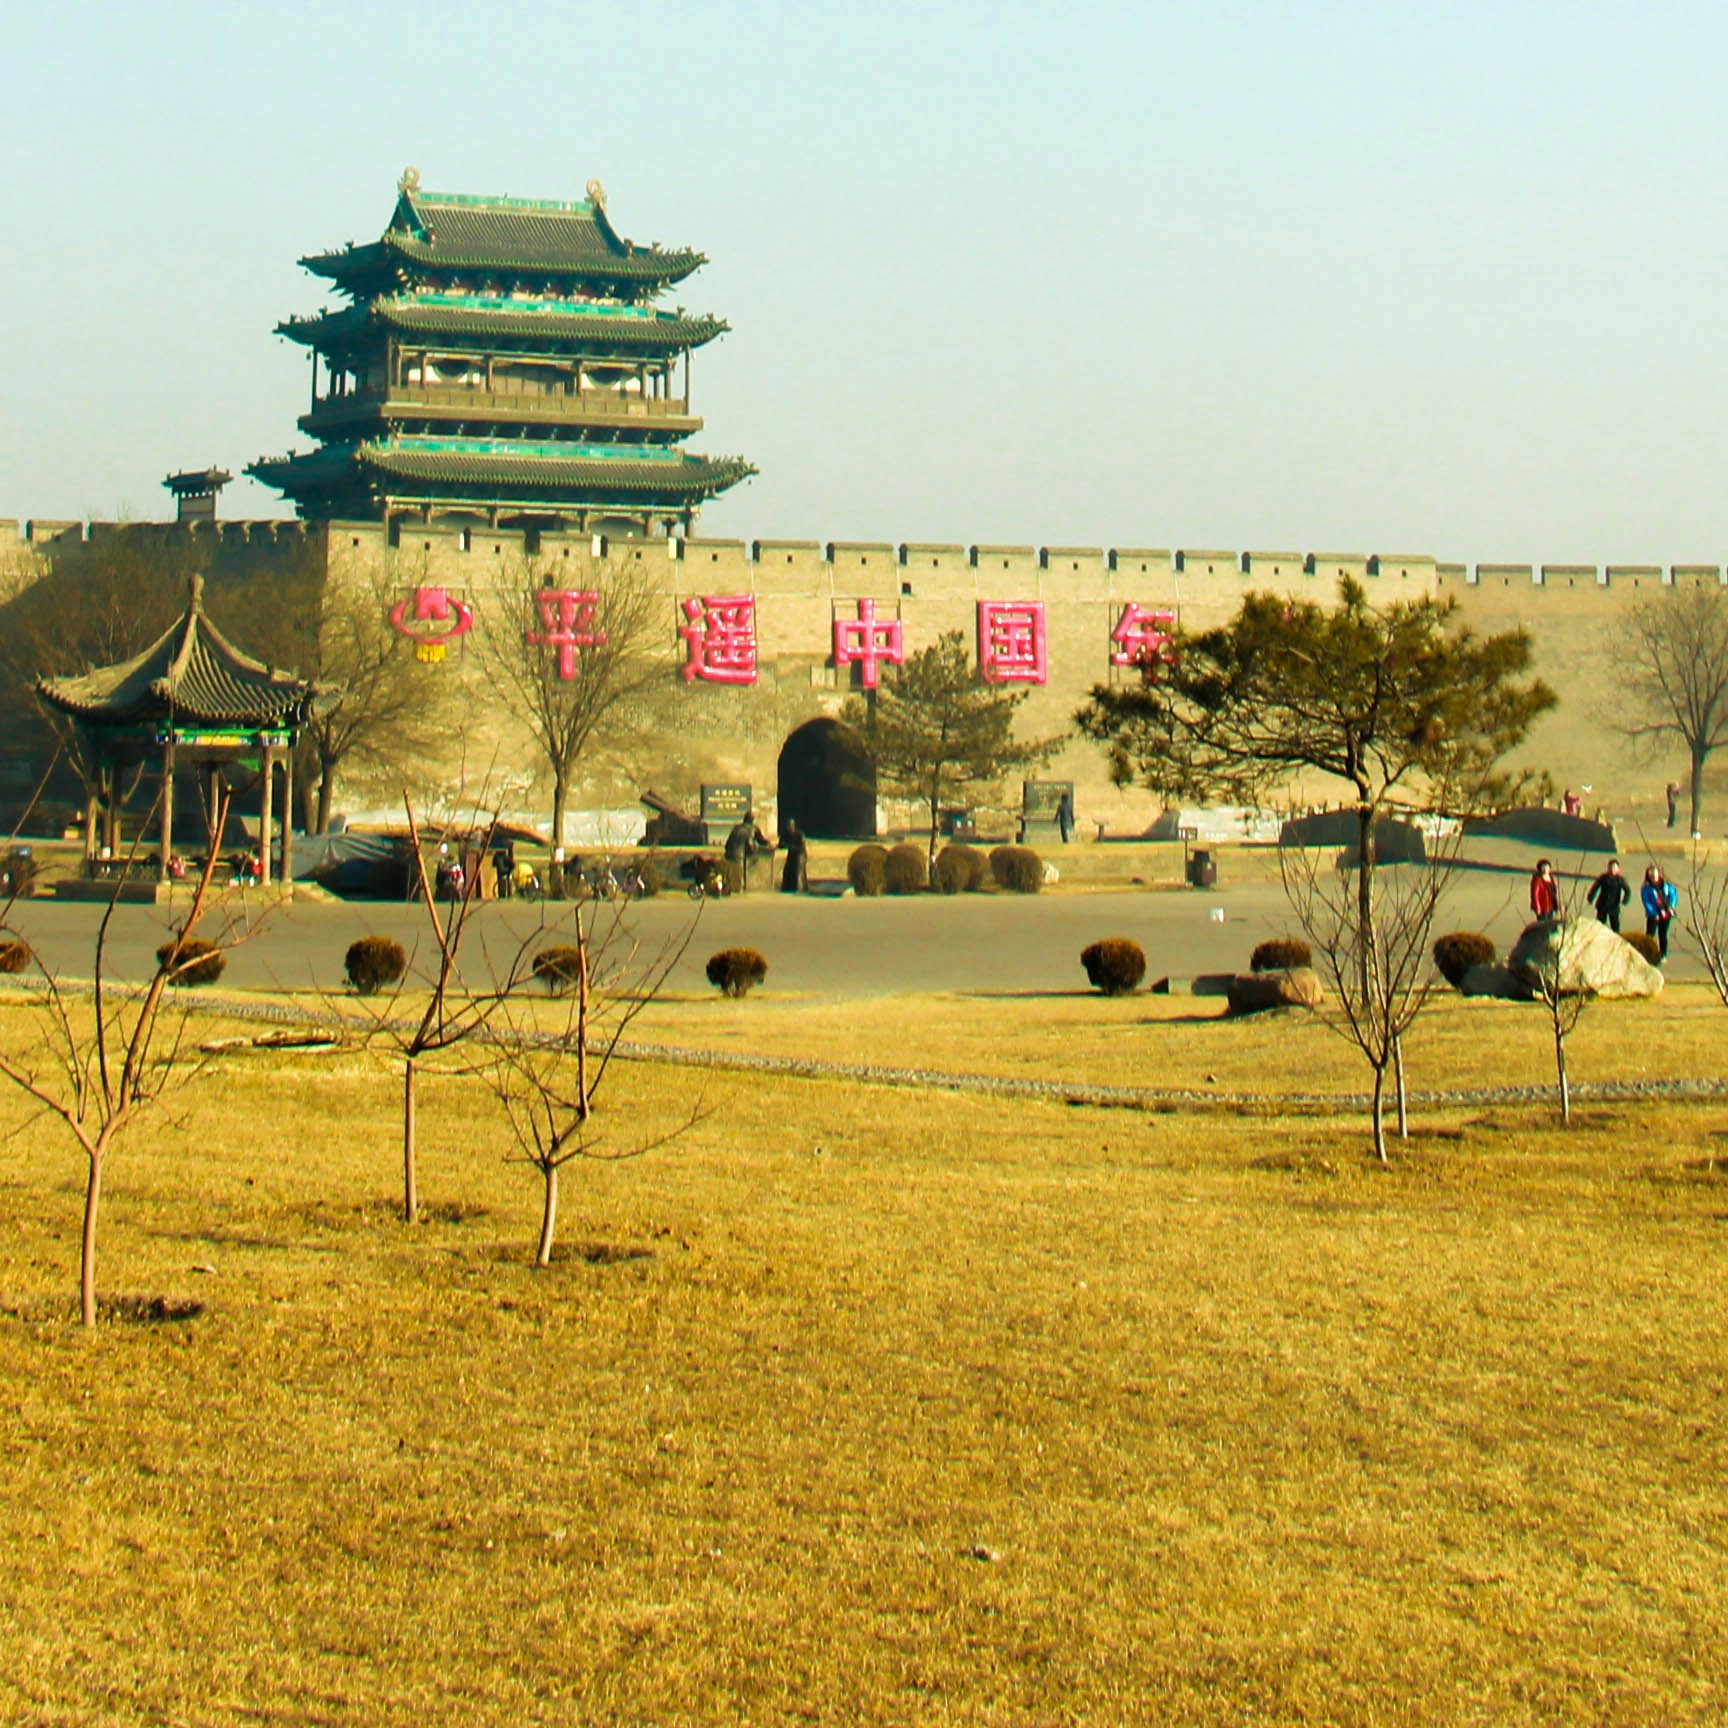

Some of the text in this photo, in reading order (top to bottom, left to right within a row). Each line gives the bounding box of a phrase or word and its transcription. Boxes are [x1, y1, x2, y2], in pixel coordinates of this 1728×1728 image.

[526, 589, 1178, 689] 平遥中国年
